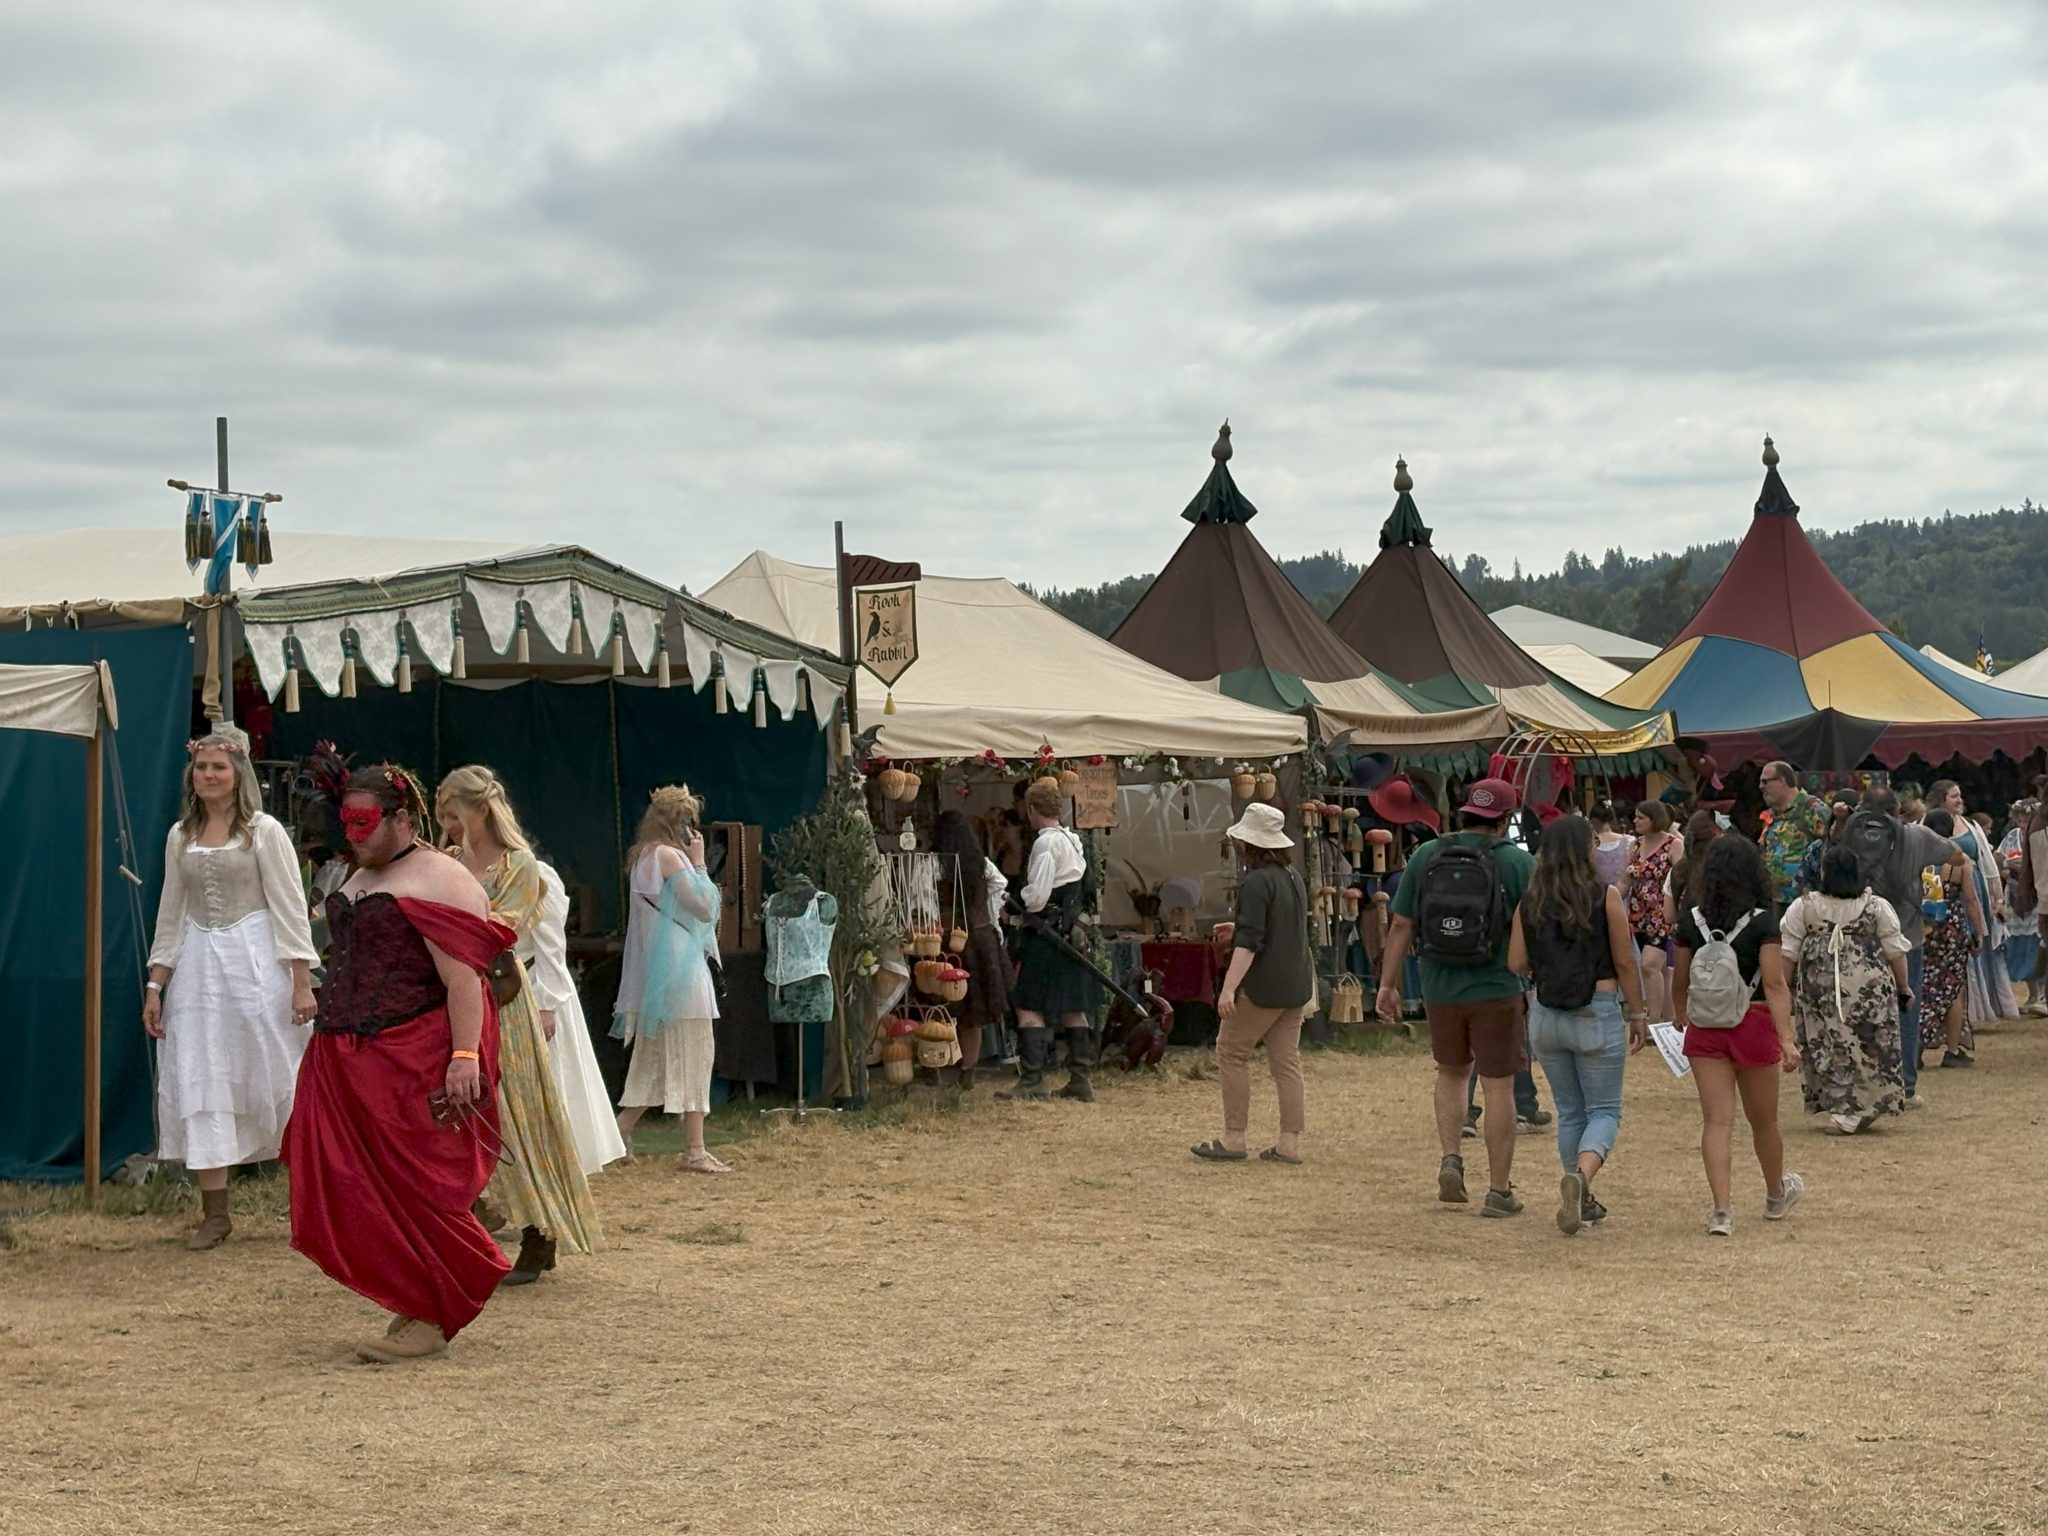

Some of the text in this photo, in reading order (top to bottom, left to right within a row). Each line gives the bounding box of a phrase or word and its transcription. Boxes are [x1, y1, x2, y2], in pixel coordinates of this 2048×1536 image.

[868, 593, 901, 611] Rook
[881, 620, 892, 638] &
[867, 646, 908, 664] Rabbit
